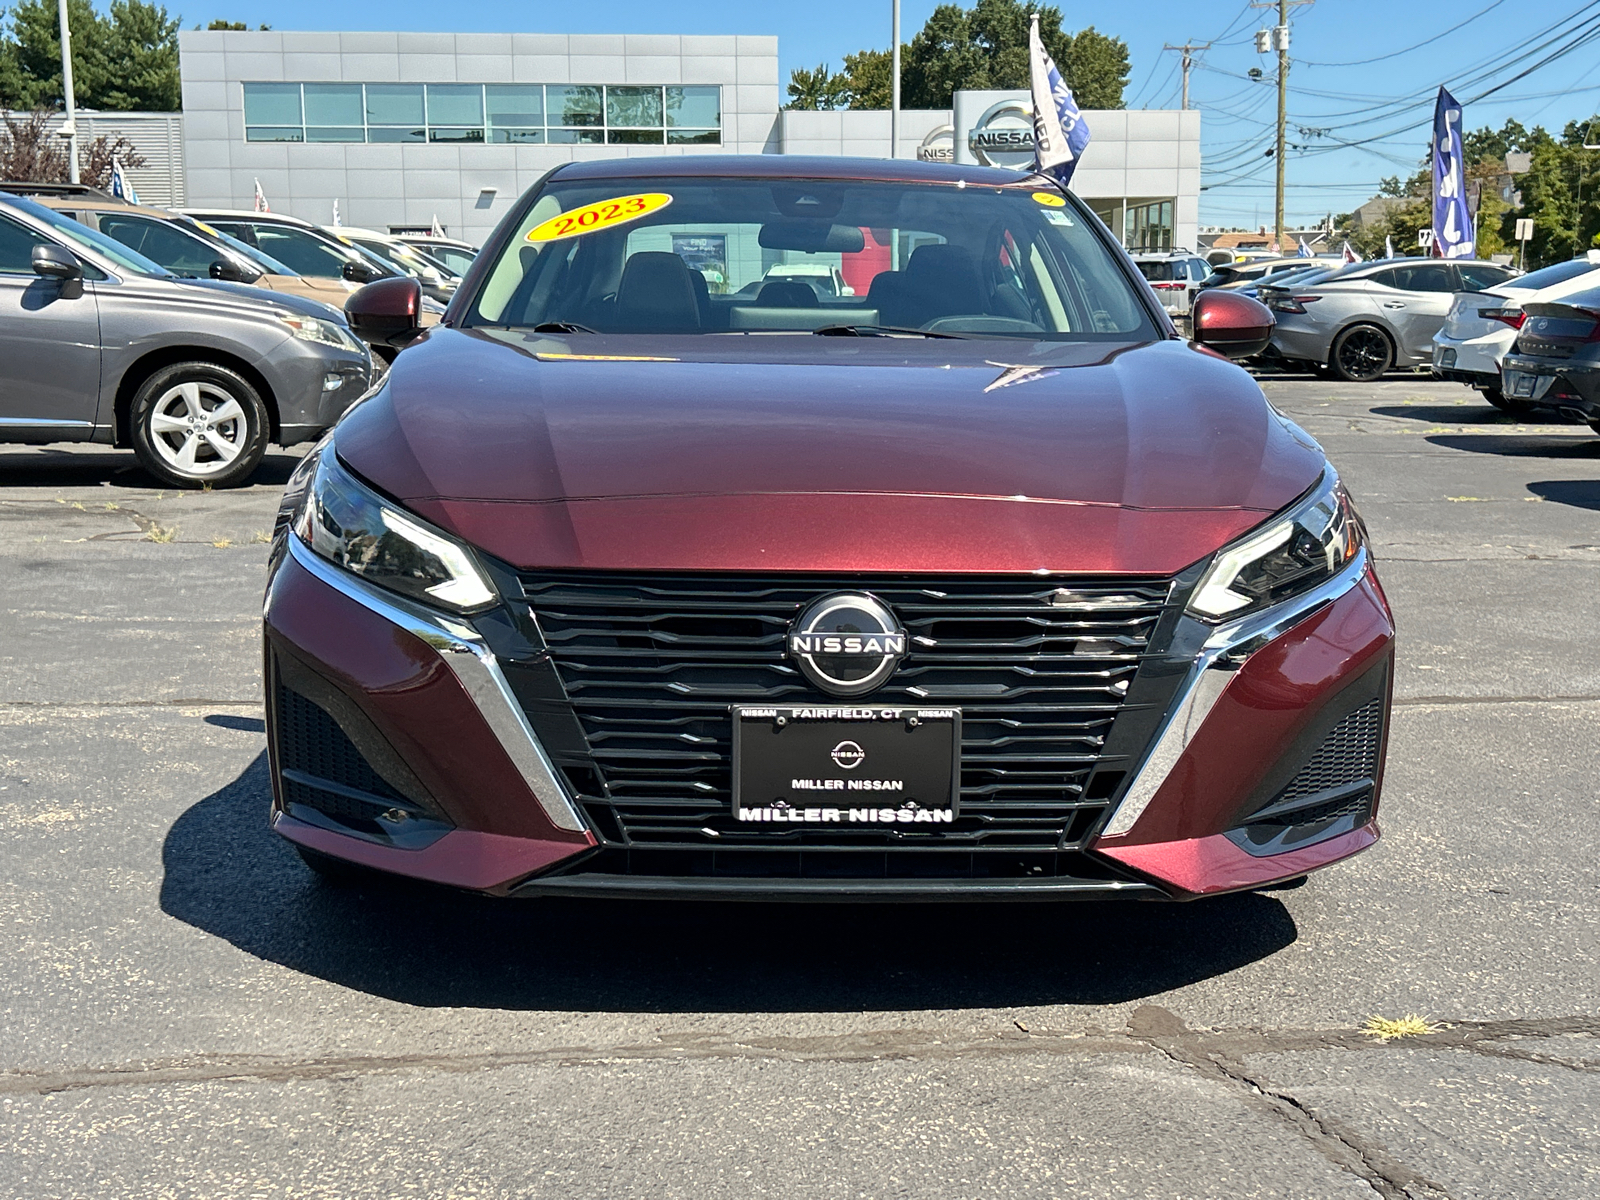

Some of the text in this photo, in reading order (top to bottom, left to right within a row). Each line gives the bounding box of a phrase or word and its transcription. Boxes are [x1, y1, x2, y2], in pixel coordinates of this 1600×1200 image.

[977, 132, 1034, 147] NISSA
[923, 149, 953, 158] NISS
[554, 197, 647, 236] 2023
[793, 636, 903, 653] NISSAN
[741, 709, 777, 717] NISSAN
[792, 709, 903, 719] FAIRFIELD, CT
[918, 710, 953, 718] NISSAN
[792, 779, 903, 791] MILLER NISSAN
[739, 807, 953, 823] MILLER NISSAN
